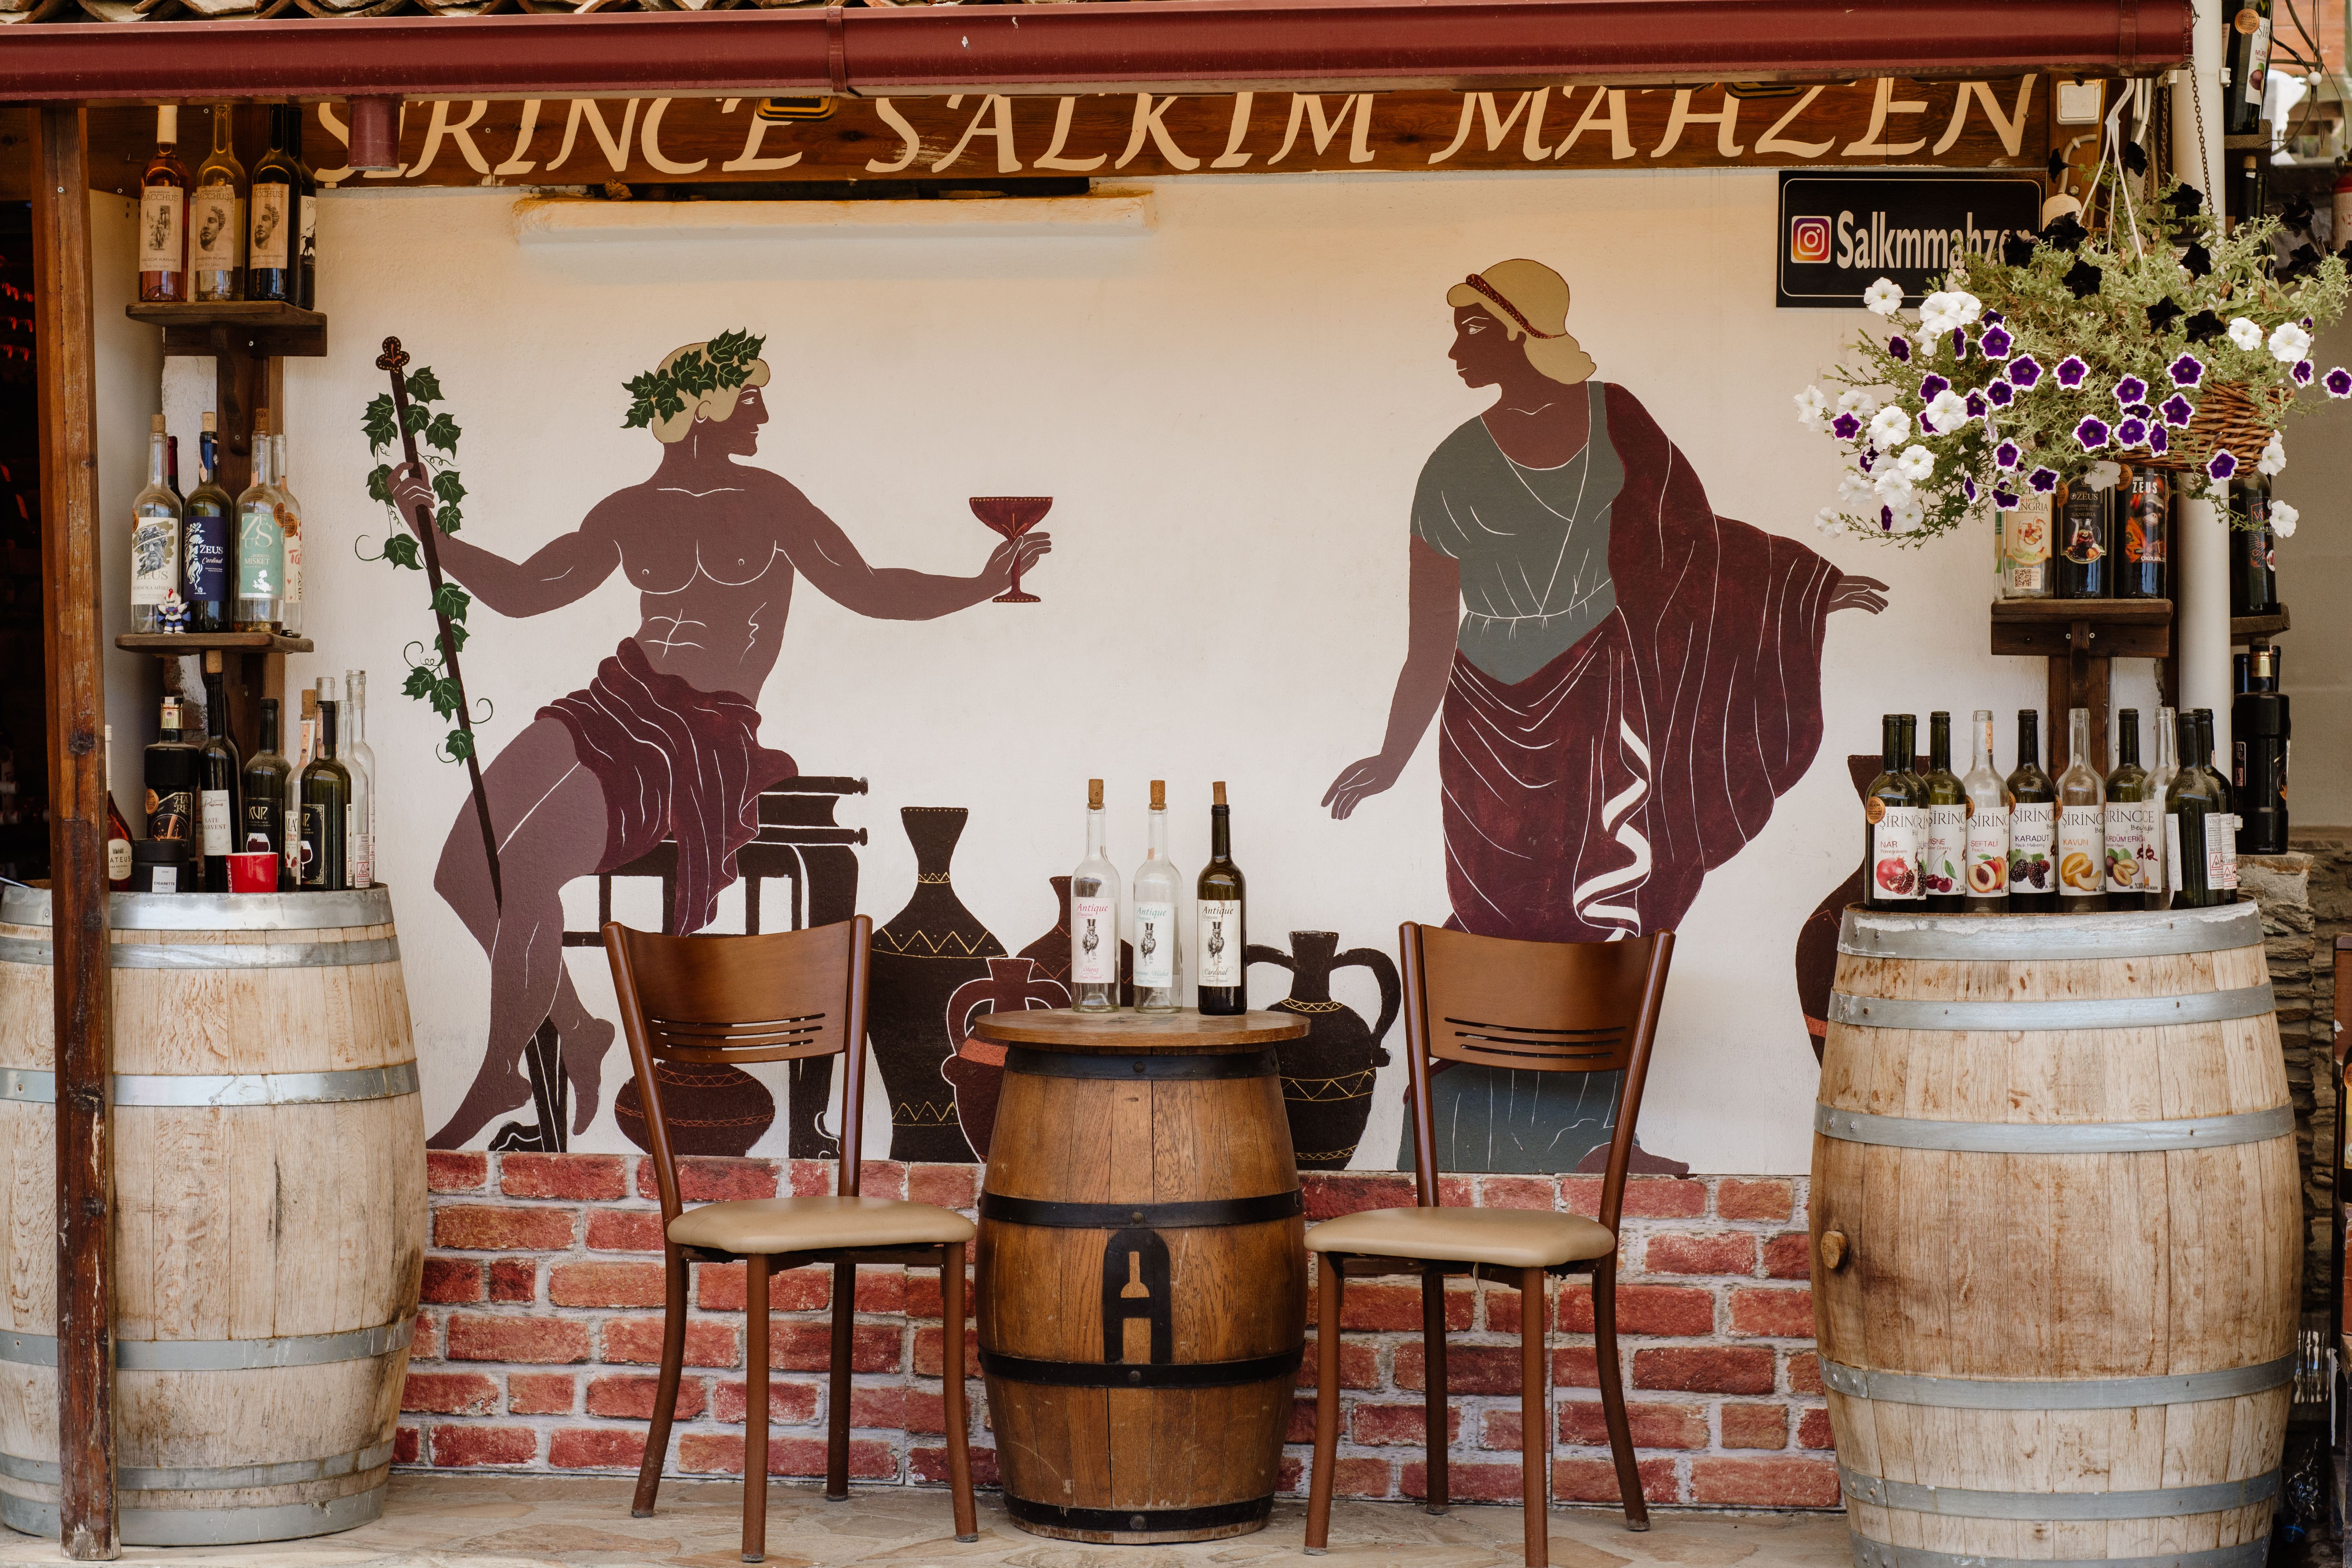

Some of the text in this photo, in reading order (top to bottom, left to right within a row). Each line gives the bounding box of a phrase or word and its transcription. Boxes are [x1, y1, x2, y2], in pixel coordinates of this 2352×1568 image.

[865, 92, 1376, 173] SALKIM
[1428, 73, 2038, 165] MAHZEN
[2133, 482, 2157, 494] ZEUS
[2019, 501, 2048, 512] NGRIA
[200, 545, 223, 554] ZEUS
[2015, 835, 2049, 843] KARADUT
[1076, 903, 1108, 915] Antique
[1136, 907, 1167, 919] Antique
[1202, 906, 1233, 918] Antique
[1081, 965, 1099, 975] Shiraz
[1202, 966, 1233, 978] Cardinal
